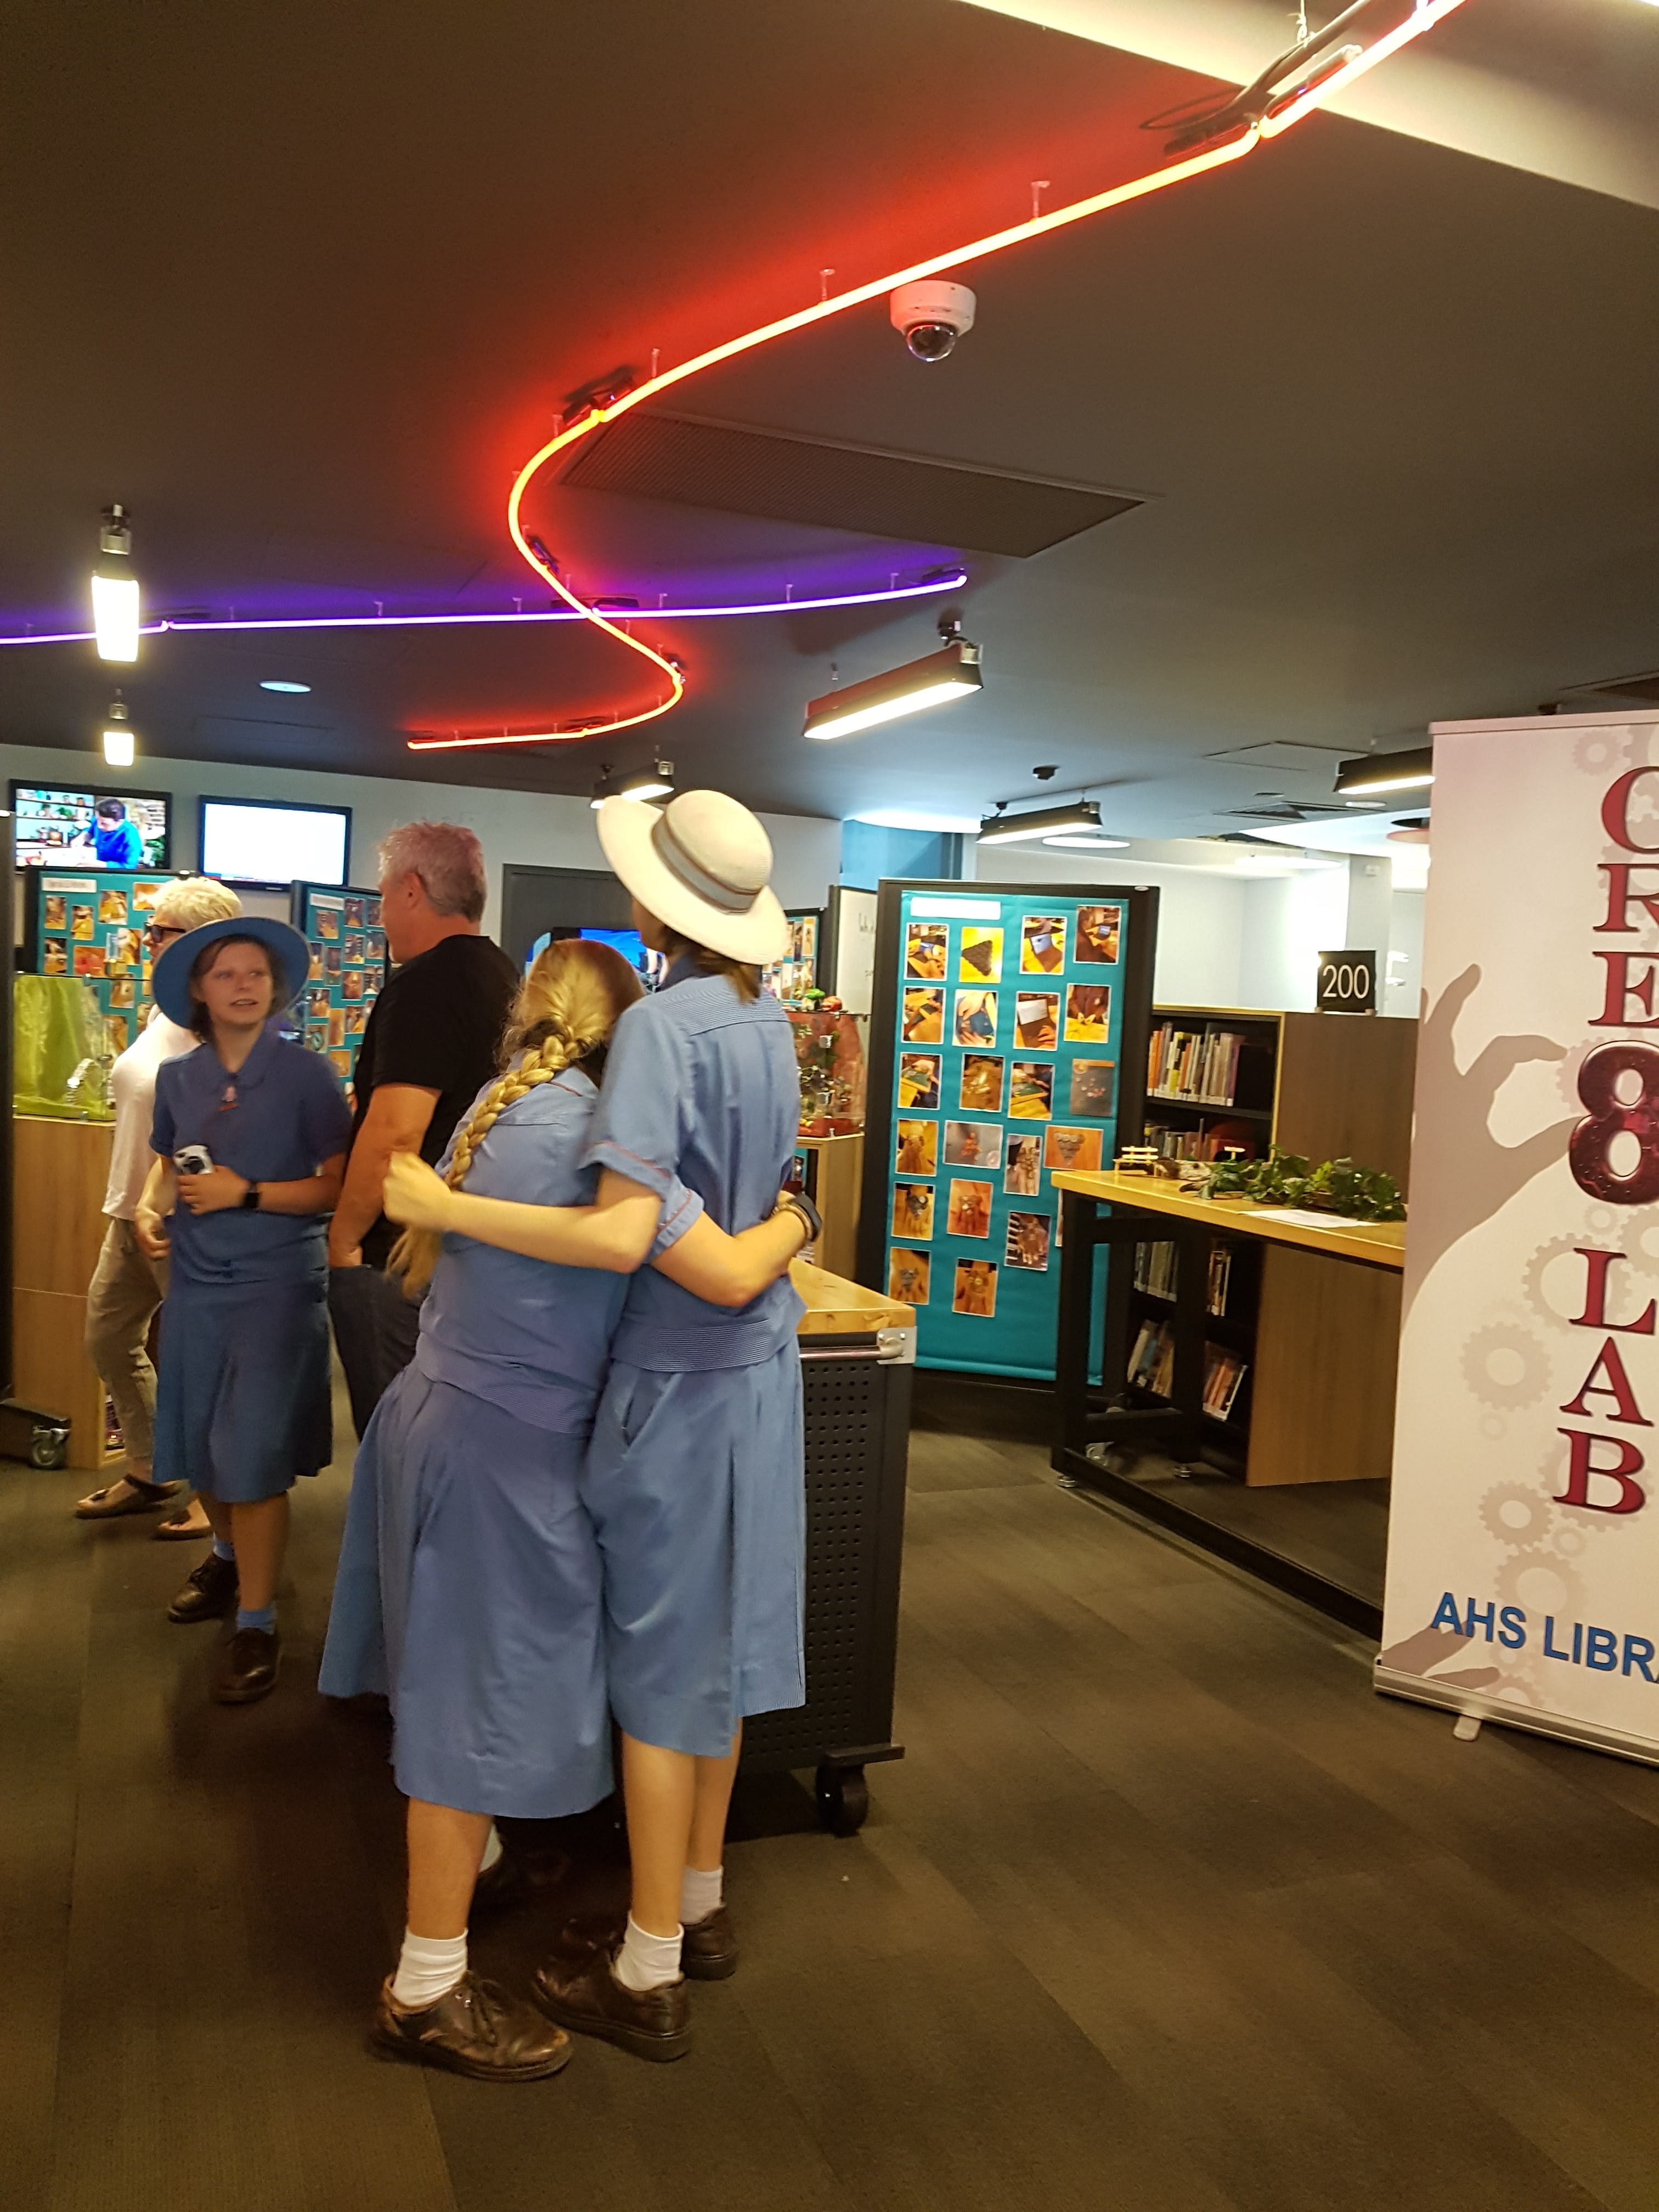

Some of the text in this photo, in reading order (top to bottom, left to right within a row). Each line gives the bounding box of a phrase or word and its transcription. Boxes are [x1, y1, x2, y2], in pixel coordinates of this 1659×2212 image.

[1323, 964, 1370, 999] 200
[1553, 1247, 1657, 1516] LAB
[1431, 1592, 1659, 1684] AHS LIBR
